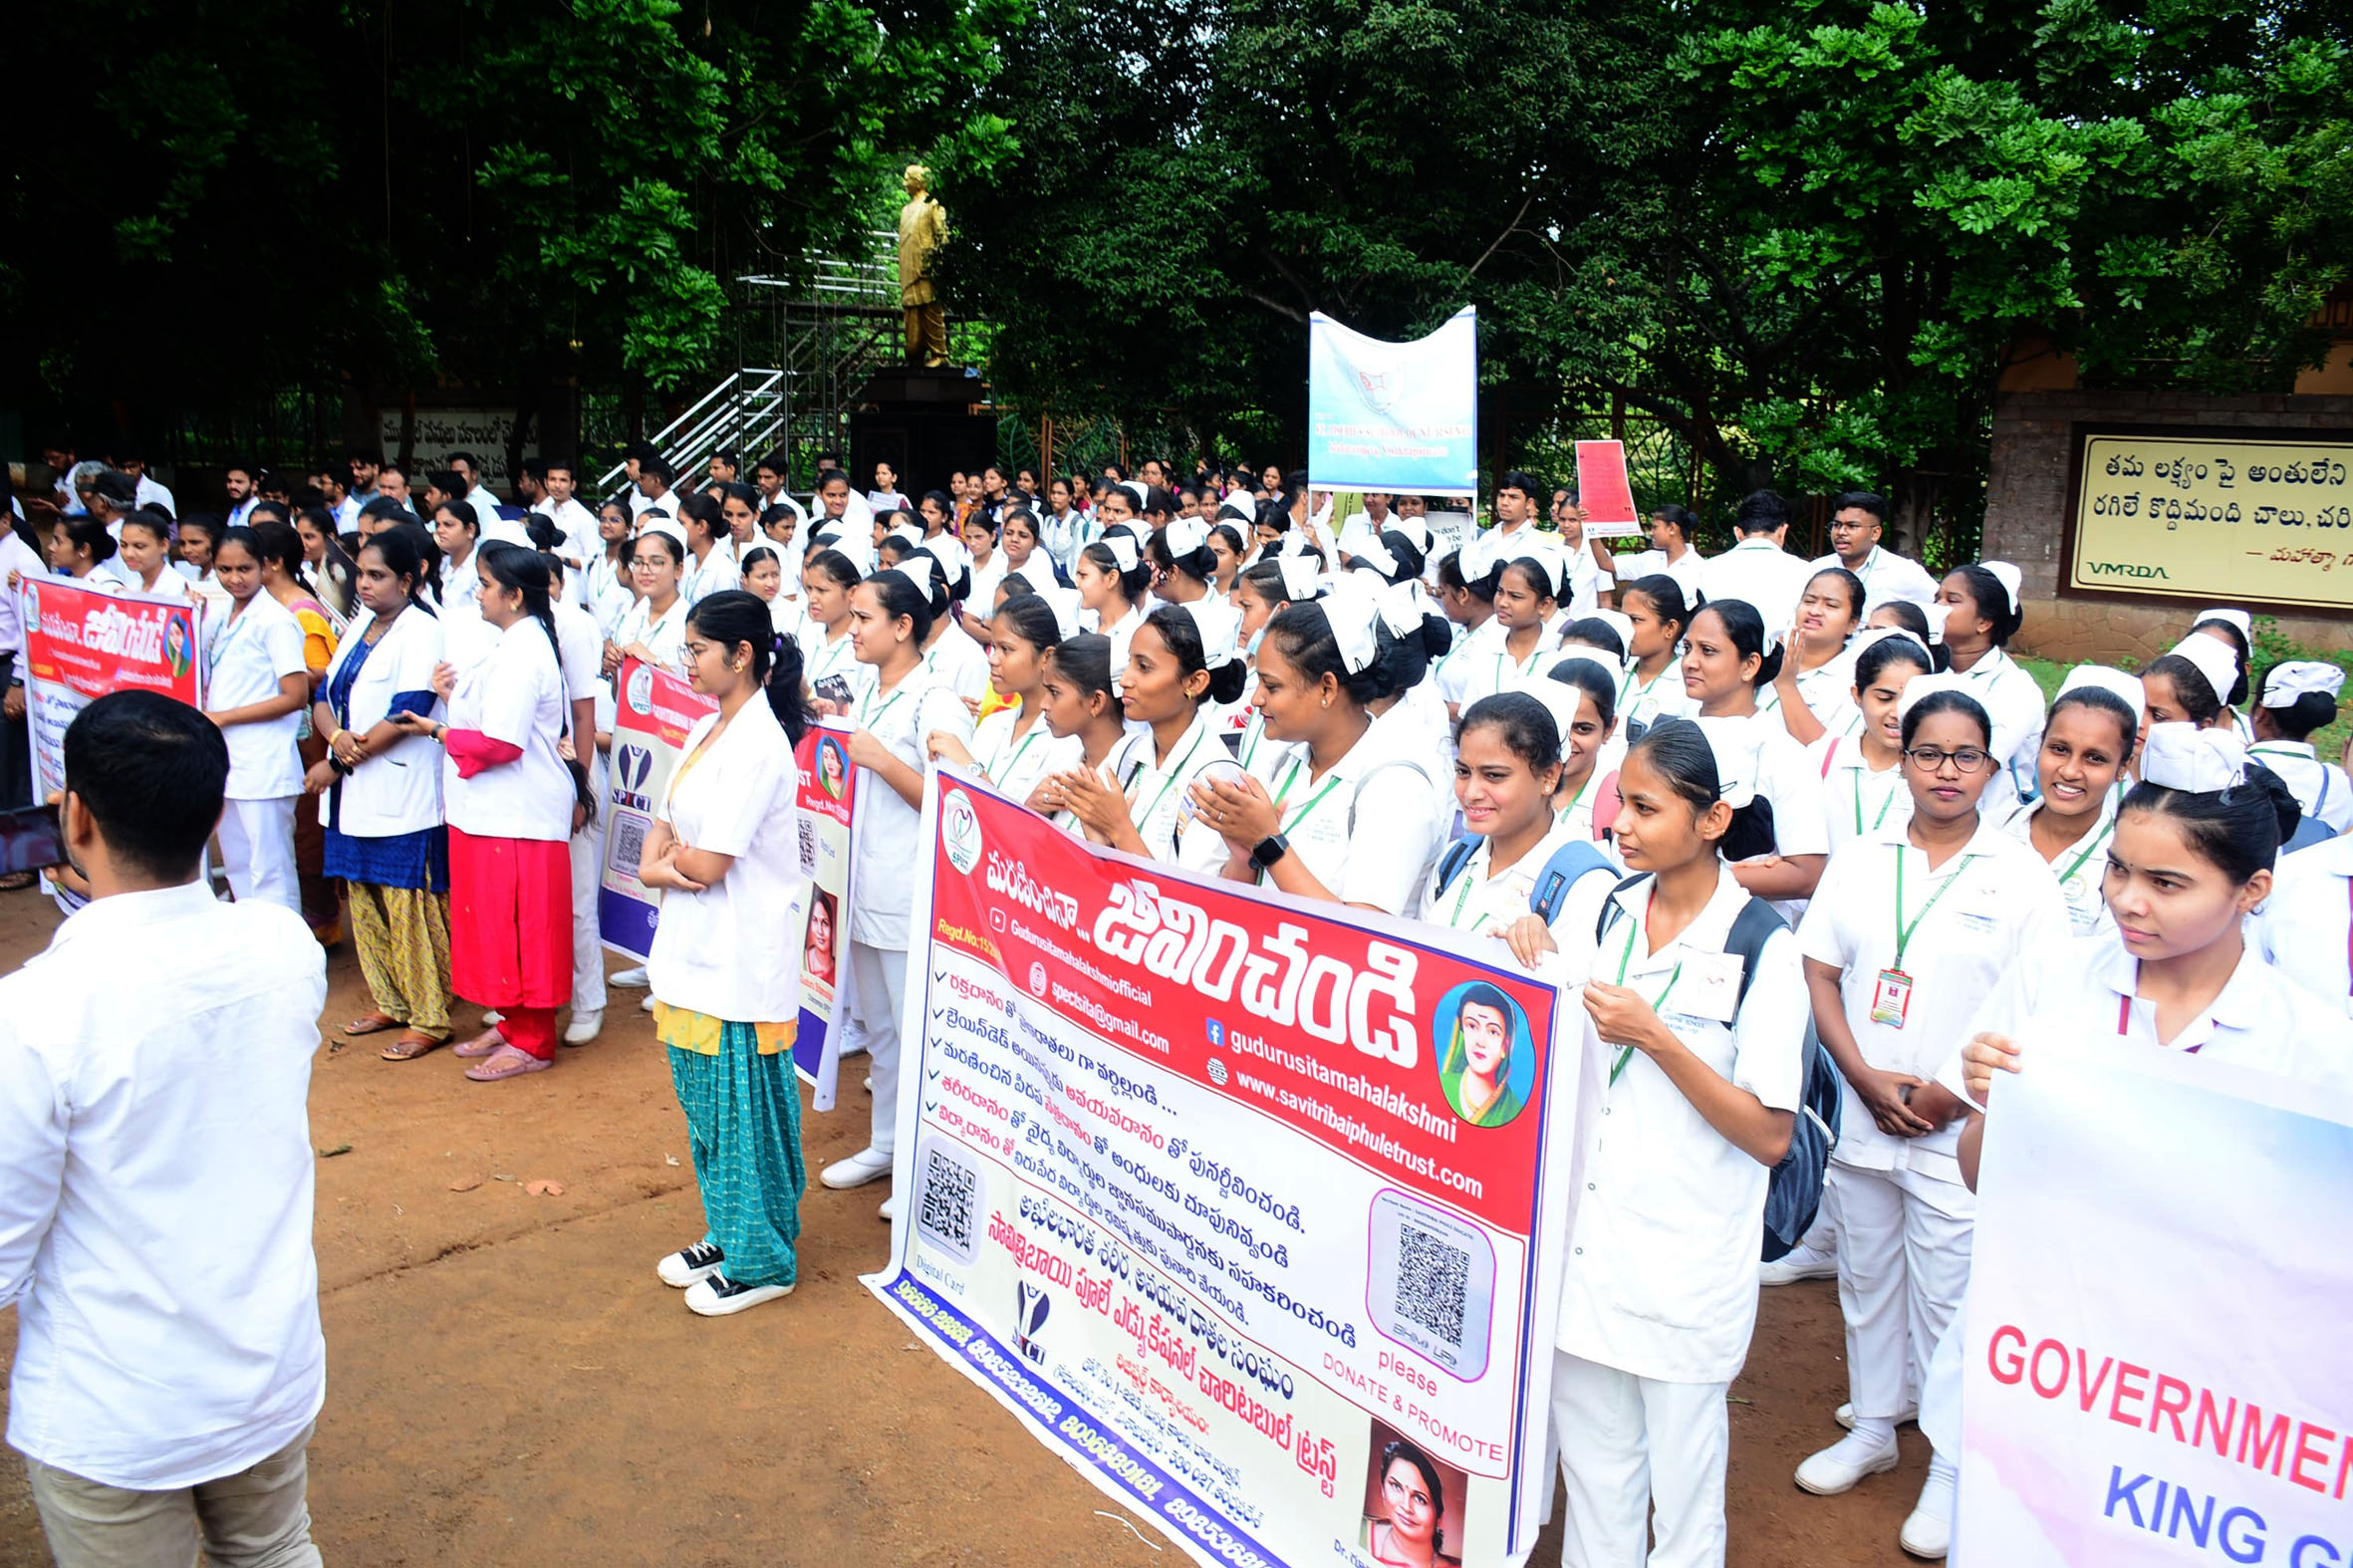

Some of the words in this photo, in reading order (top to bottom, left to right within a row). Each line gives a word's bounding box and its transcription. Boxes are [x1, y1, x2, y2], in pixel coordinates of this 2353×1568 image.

[2105, 454, 2143, 477] తమ
[2155, 457, 2209, 489] లక్ష్యం
[2215, 458, 2236, 489] పై
[2248, 458, 2347, 485] అంతులేని
[2093, 492, 2141, 517] రగిలే
[2149, 497, 2241, 531] కొద్దిమంది
[2317, 505, 2353, 529] చరి
[2086, 561, 2171, 580] VMRDA
[613, 788, 651, 813] SPECT
[950, 973, 1004, 1011] రక్తదానం
[1094, 878, 1419, 1069] జీవించండి
[1230, 1028, 1456, 1144] gudurusitamahalakshmi
[1065, 1085, 1165, 1151] అవయవదానం
[1167, 1137, 1188, 1160] తో
[1236, 1069, 1483, 1200] www.savitribaiphuletrust.com
[944, 1042, 1012, 1087] మరణించిన
[1112, 1151, 1181, 1202] అంధులకు
[1183, 1194, 1289, 1268] చూపునివ్వండి
[916, 1254, 944, 1280] Digital
[944, 1272, 965, 1296] Card
[1228, 1260, 1357, 1349] సహకరించండి
[1378, 1348, 1438, 1397] please
[1323, 1352, 1388, 1404] DONATE
[1392, 1395, 1404, 1413] &
[1407, 1405, 1504, 1462] PROMOTE
[2104, 1465, 2267, 1565] KING
[1334, 1539, 1348, 1560] Dr.
